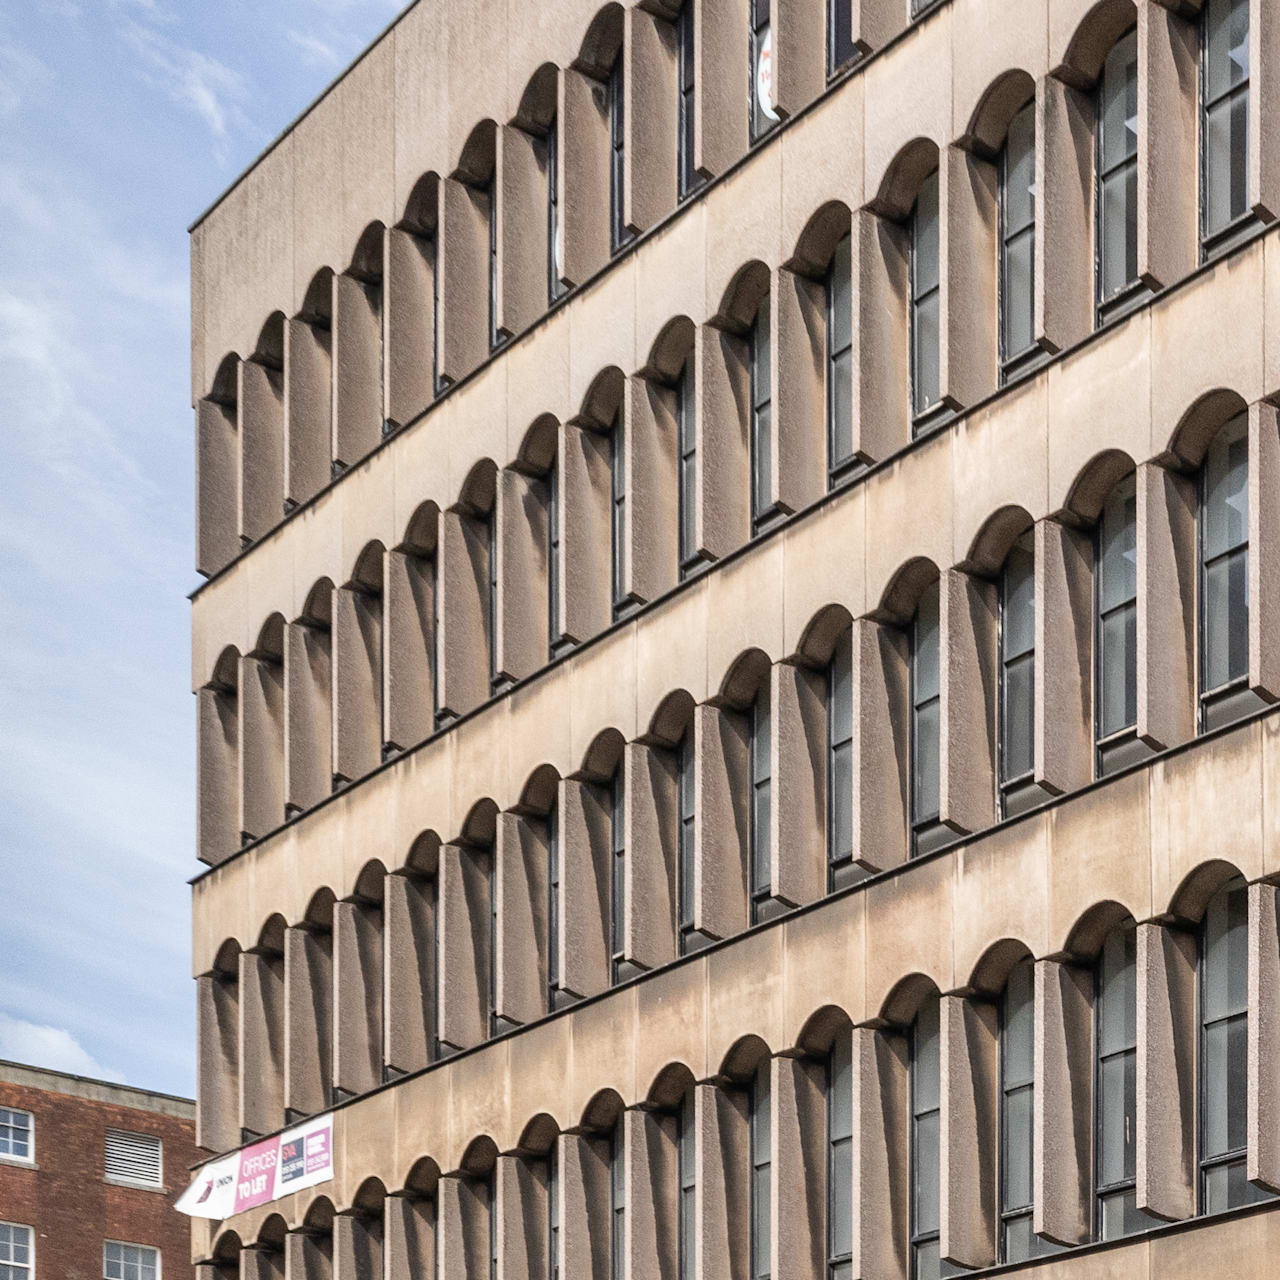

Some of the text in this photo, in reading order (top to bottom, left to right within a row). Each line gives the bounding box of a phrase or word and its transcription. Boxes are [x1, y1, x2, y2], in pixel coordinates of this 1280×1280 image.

[242, 1149, 277, 1177] OFFICES
[238, 1174, 268, 1200] TO LET
